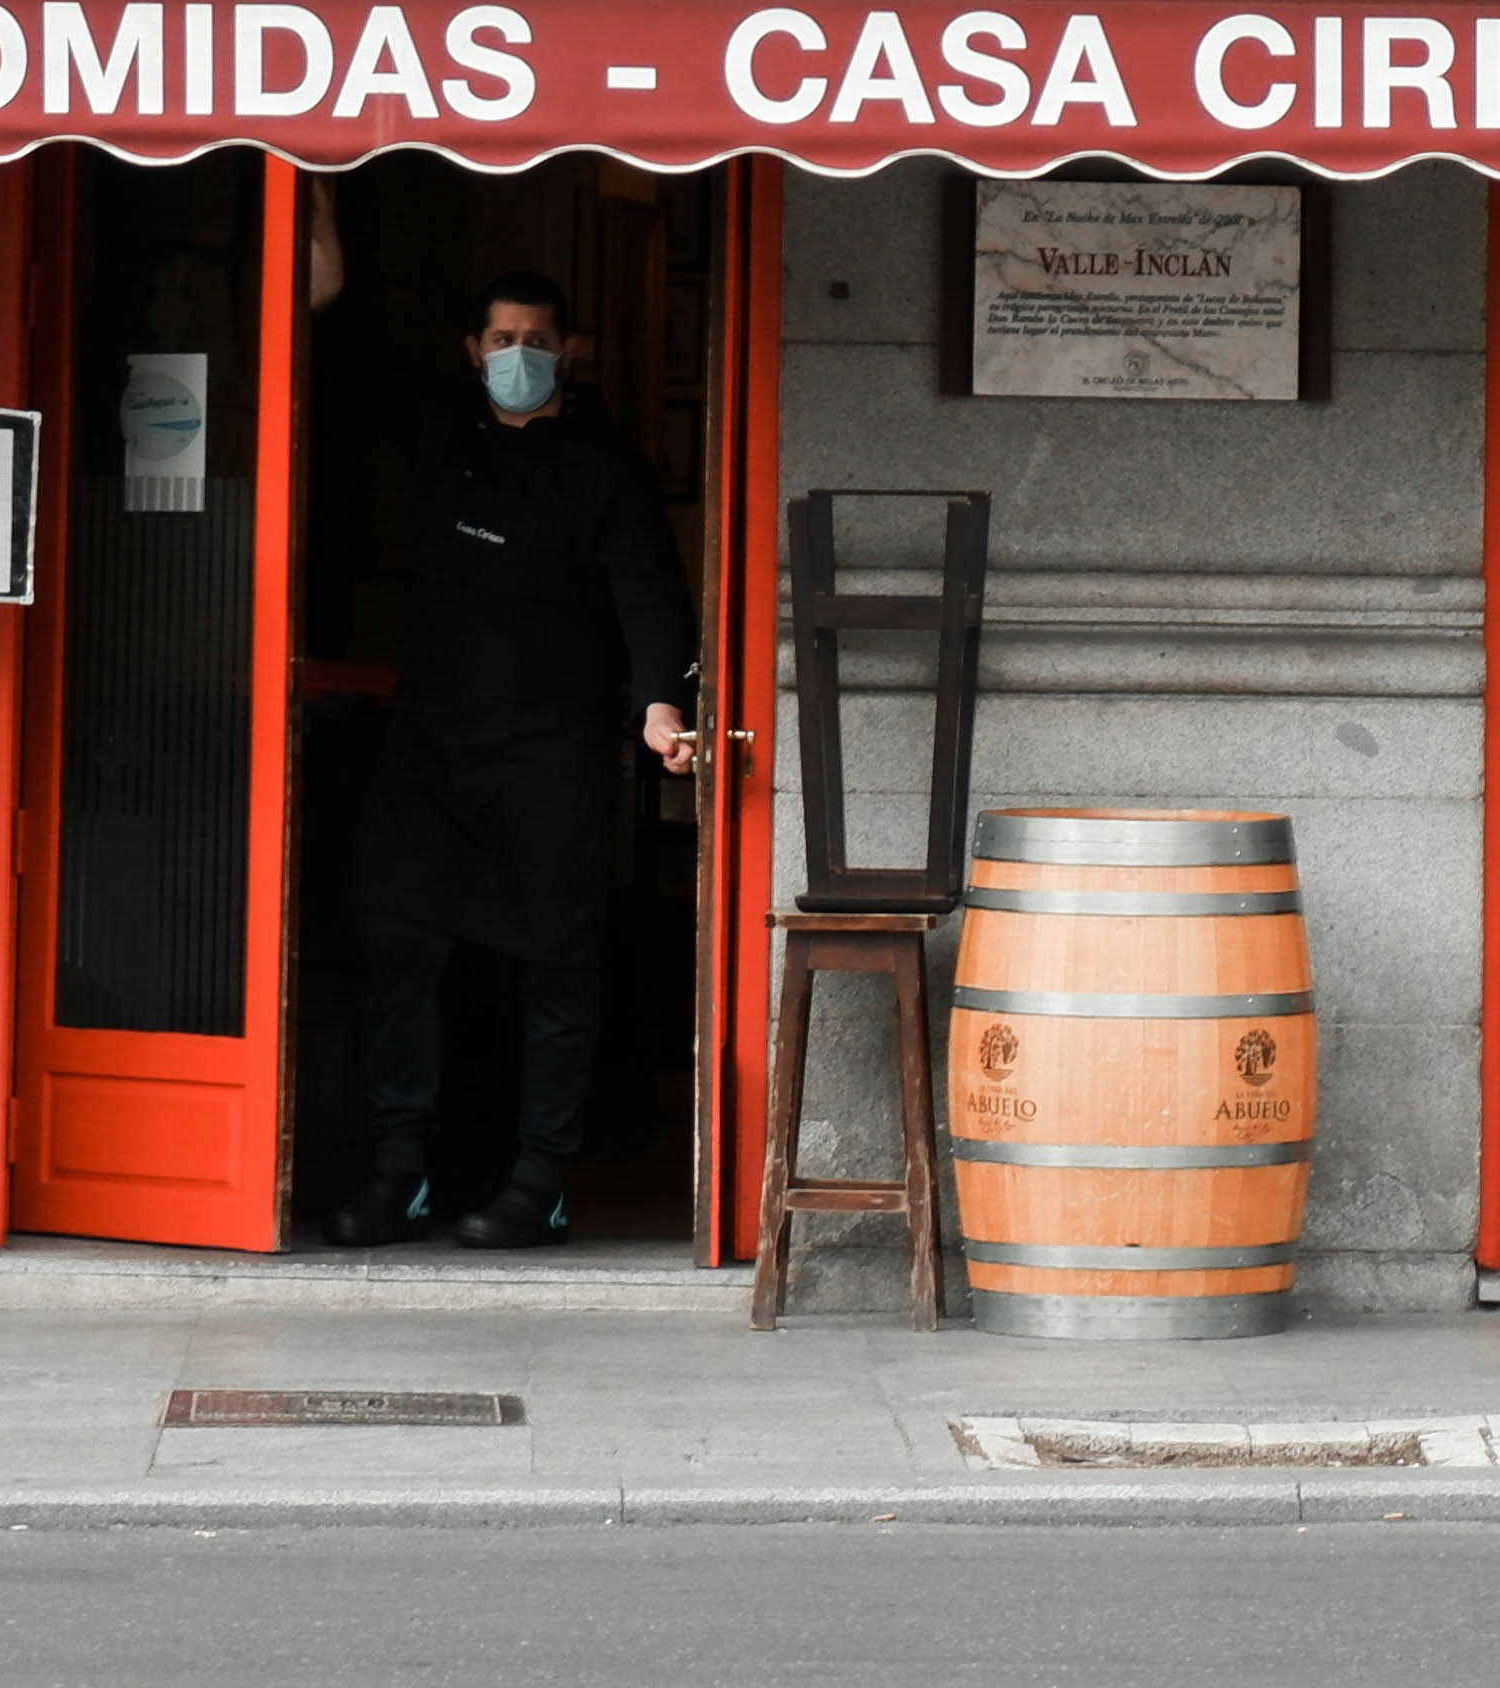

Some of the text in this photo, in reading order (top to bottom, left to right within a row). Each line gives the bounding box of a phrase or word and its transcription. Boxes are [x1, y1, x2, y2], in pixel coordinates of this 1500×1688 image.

[724, 8, 1137, 127] CASA
[967, 1092, 1037, 1123] ABUELO
[1213, 1099, 1291, 1122] ABUELO
